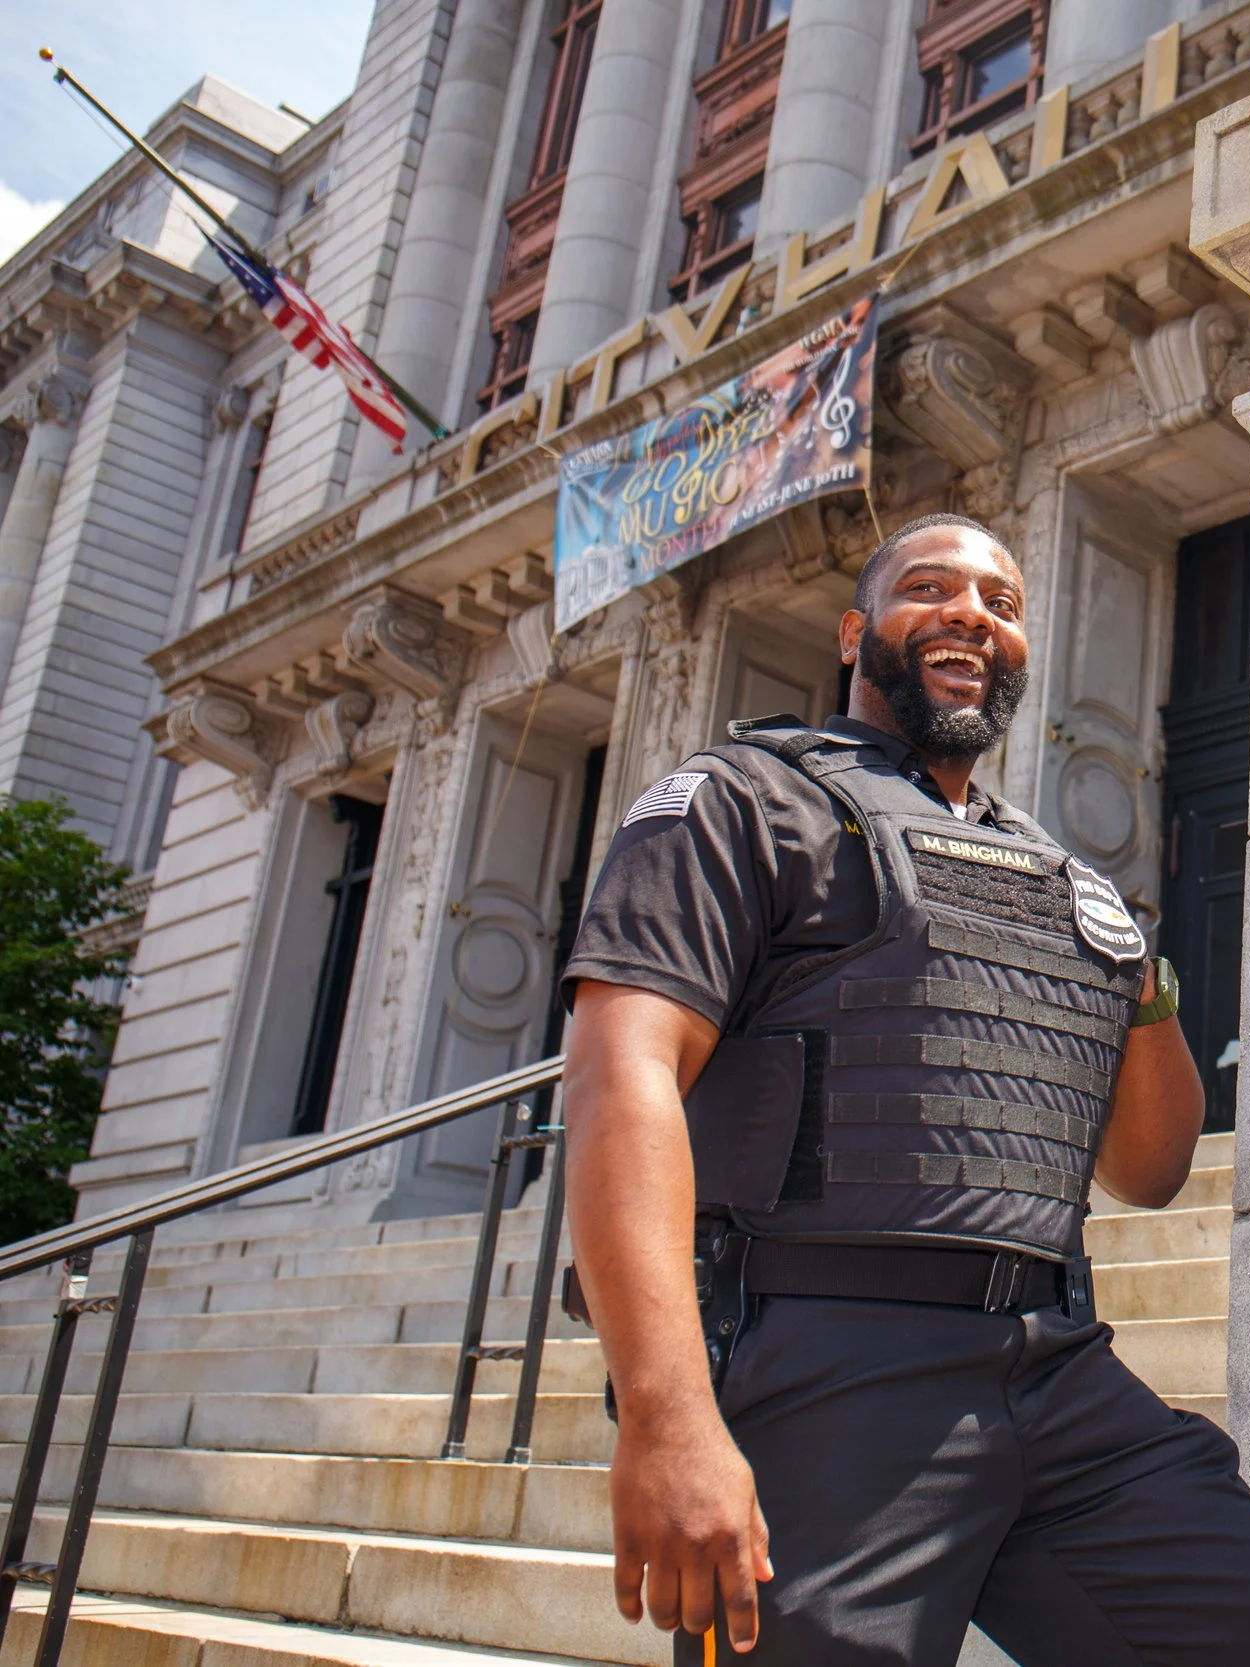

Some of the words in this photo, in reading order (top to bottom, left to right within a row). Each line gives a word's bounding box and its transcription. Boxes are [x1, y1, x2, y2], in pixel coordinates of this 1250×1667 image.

[461, 262, 755, 482] CITY
[640, 515, 719, 576] MONTH
[922, 835, 945, 852] M.
[1081, 915, 1124, 945] SECURITY
